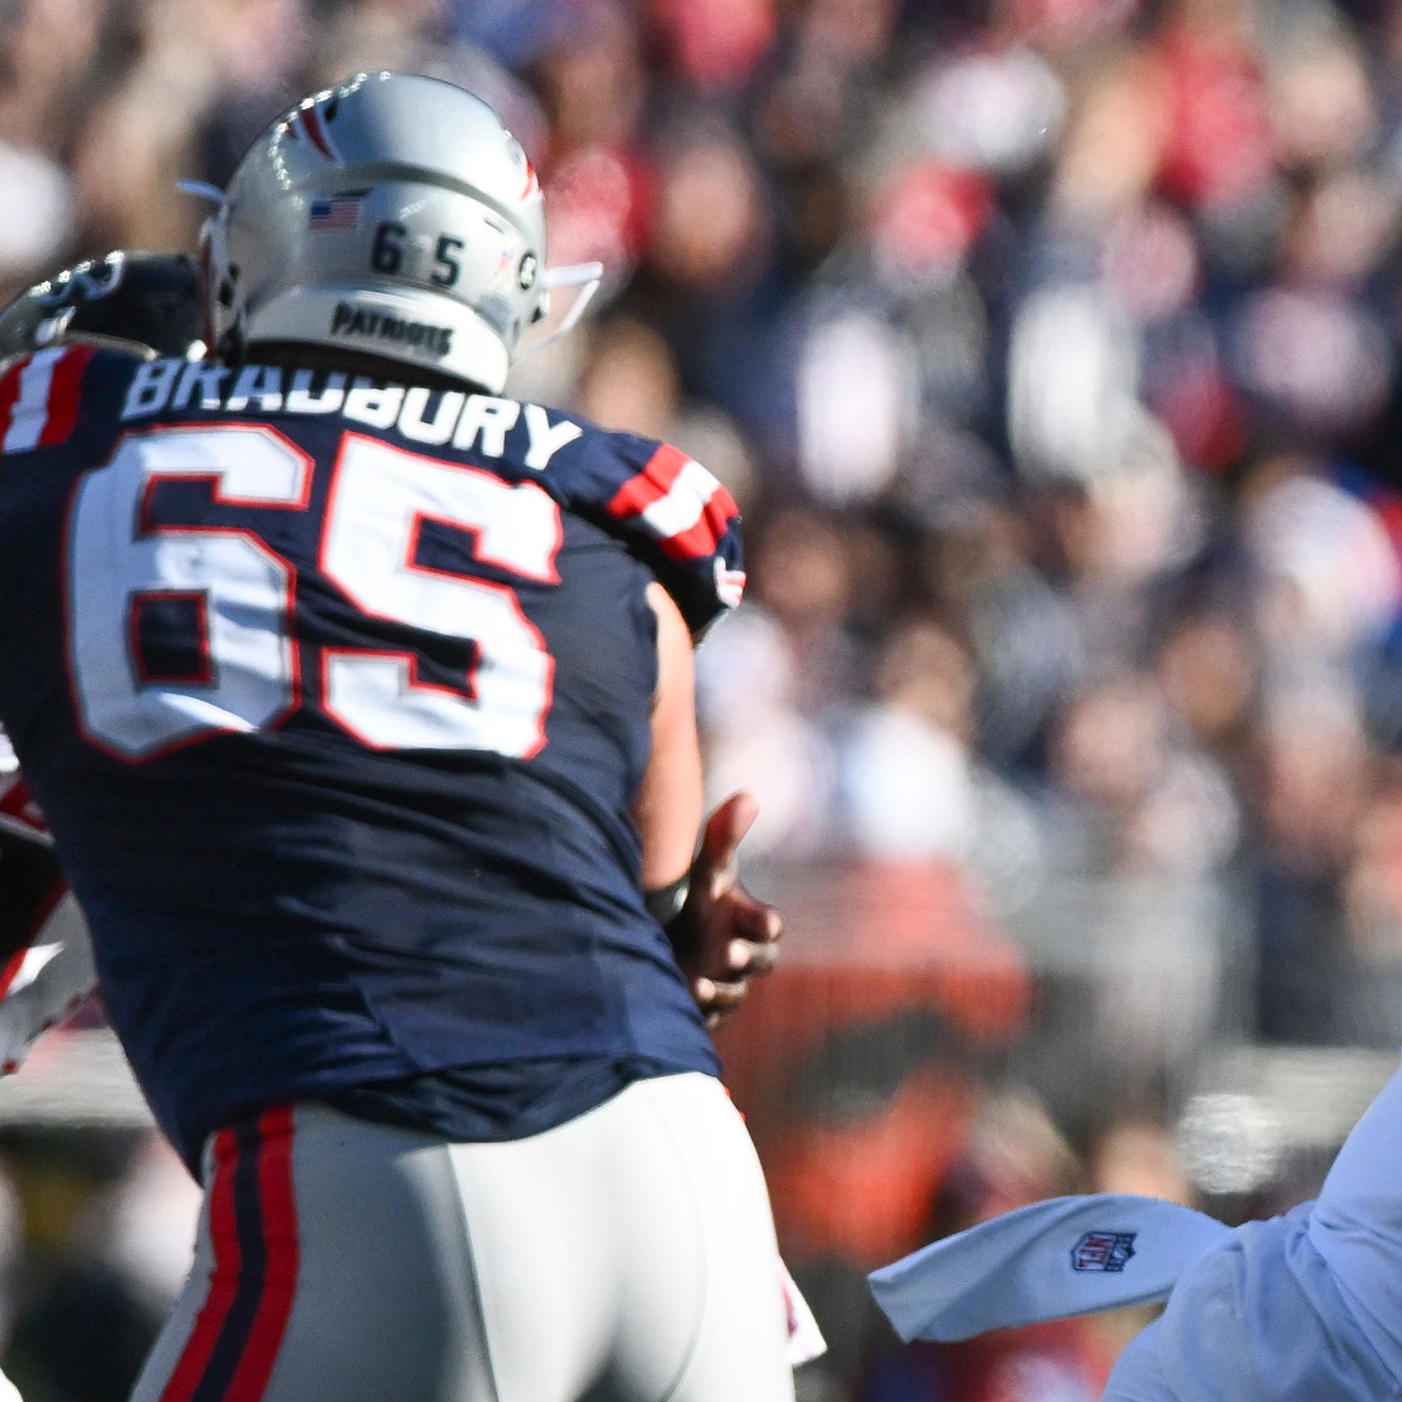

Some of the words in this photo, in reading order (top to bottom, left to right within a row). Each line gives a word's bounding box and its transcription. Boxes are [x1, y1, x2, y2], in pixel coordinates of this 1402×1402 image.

[331, 301, 454, 355] PATRIOTS
[121, 358, 584, 471] BRADBURY
[65, 422, 562, 762] 65
